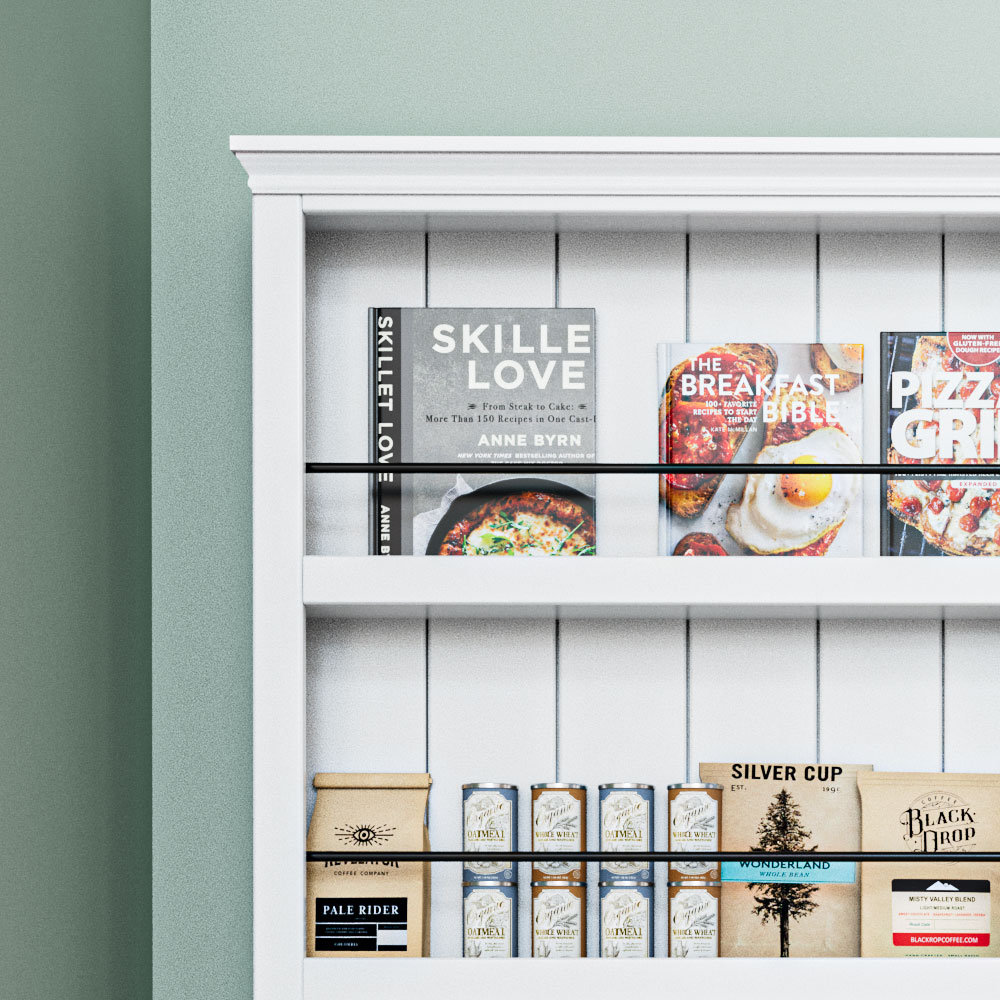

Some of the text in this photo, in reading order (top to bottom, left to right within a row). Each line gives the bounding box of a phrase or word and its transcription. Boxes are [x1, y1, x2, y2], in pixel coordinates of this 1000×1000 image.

[432, 324, 591, 354] SKILLE
[378, 316, 393, 412] SKILLET
[690, 357, 722, 372] THE
[468, 360, 586, 390] LOVE
[681, 373, 840, 396] BREAKFAST
[482, 402, 574, 411] From Steak to Cake:
[762, 401, 841, 423] BIBLE
[426, 415, 448, 423] More
[451, 415, 474, 423] Than
[477, 415, 495, 423] 150
[498, 415, 533, 425] Recipes
[536, 415, 545, 423] in
[547, 415, 566, 423] One
[477, 434, 581, 446] ANNE BYRN
[380, 504, 391, 541] ANNE
[731, 763, 843, 782] SILVER CUP
[731, 784, 747, 792] EST.
[899, 807, 974, 838] BLACK
[922, 827, 976, 852] DROP
[739, 861, 831, 870] WONDERLAND
[323, 905, 399, 915] PALE RIDER
